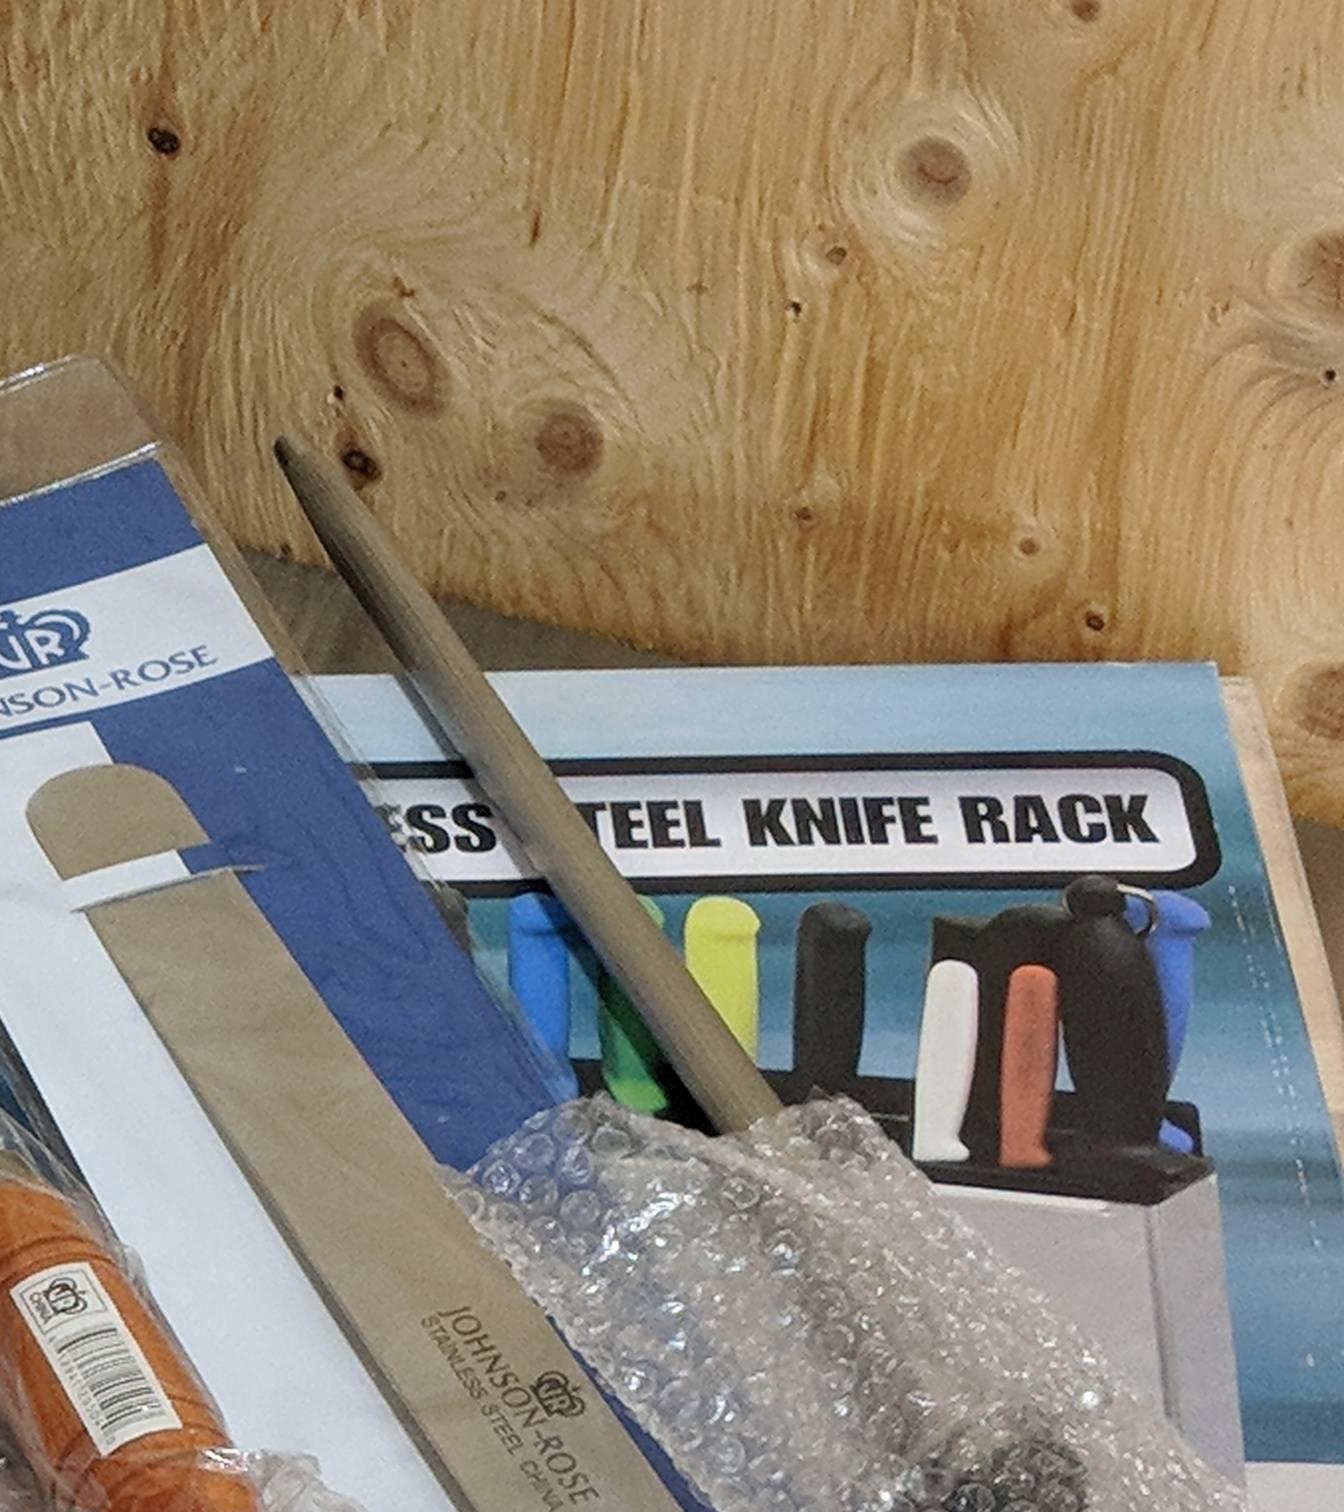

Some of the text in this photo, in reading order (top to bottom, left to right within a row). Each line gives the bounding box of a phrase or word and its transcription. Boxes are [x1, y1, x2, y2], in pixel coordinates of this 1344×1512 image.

[374, 793, 1160, 854] ESS TEEL KNIFE RACK
[420, 1315, 564, 1512] STAINLESS STEEL CHINA
[437, 1304, 601, 1506] JOHNSON-ROSE
